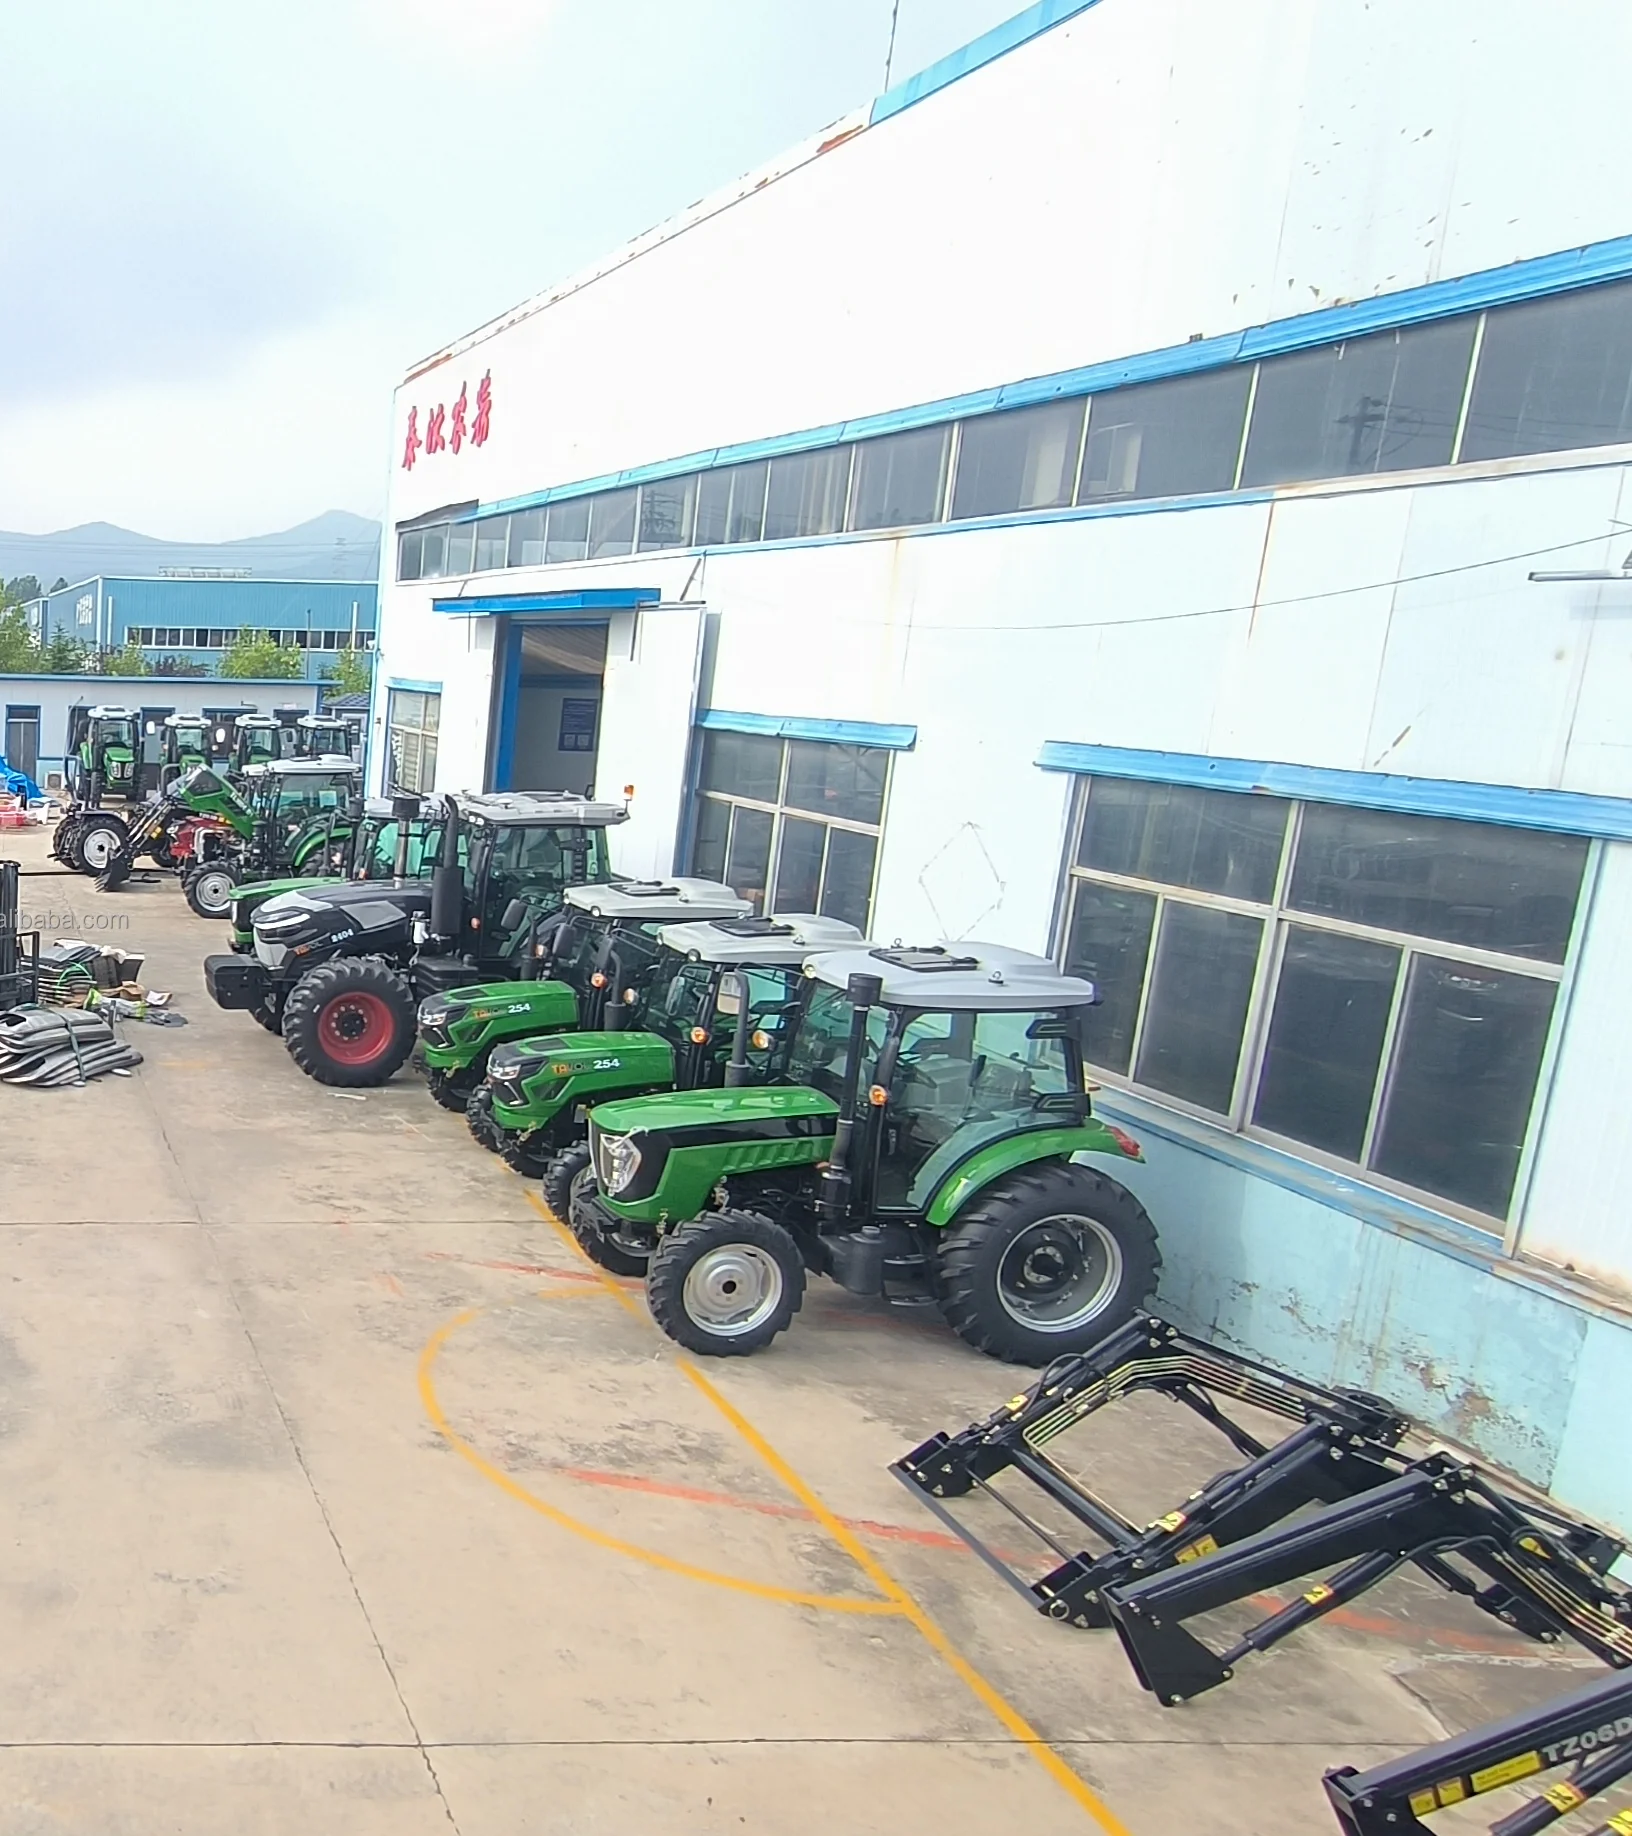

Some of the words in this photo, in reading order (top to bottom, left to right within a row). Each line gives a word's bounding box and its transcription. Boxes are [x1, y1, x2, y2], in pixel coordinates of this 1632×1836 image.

[330, 928, 355, 943] 2404
[507, 1003, 531, 1014] 254
[592, 1058, 621, 1071] 254
[1541, 1716, 1632, 1762] TZ06D
